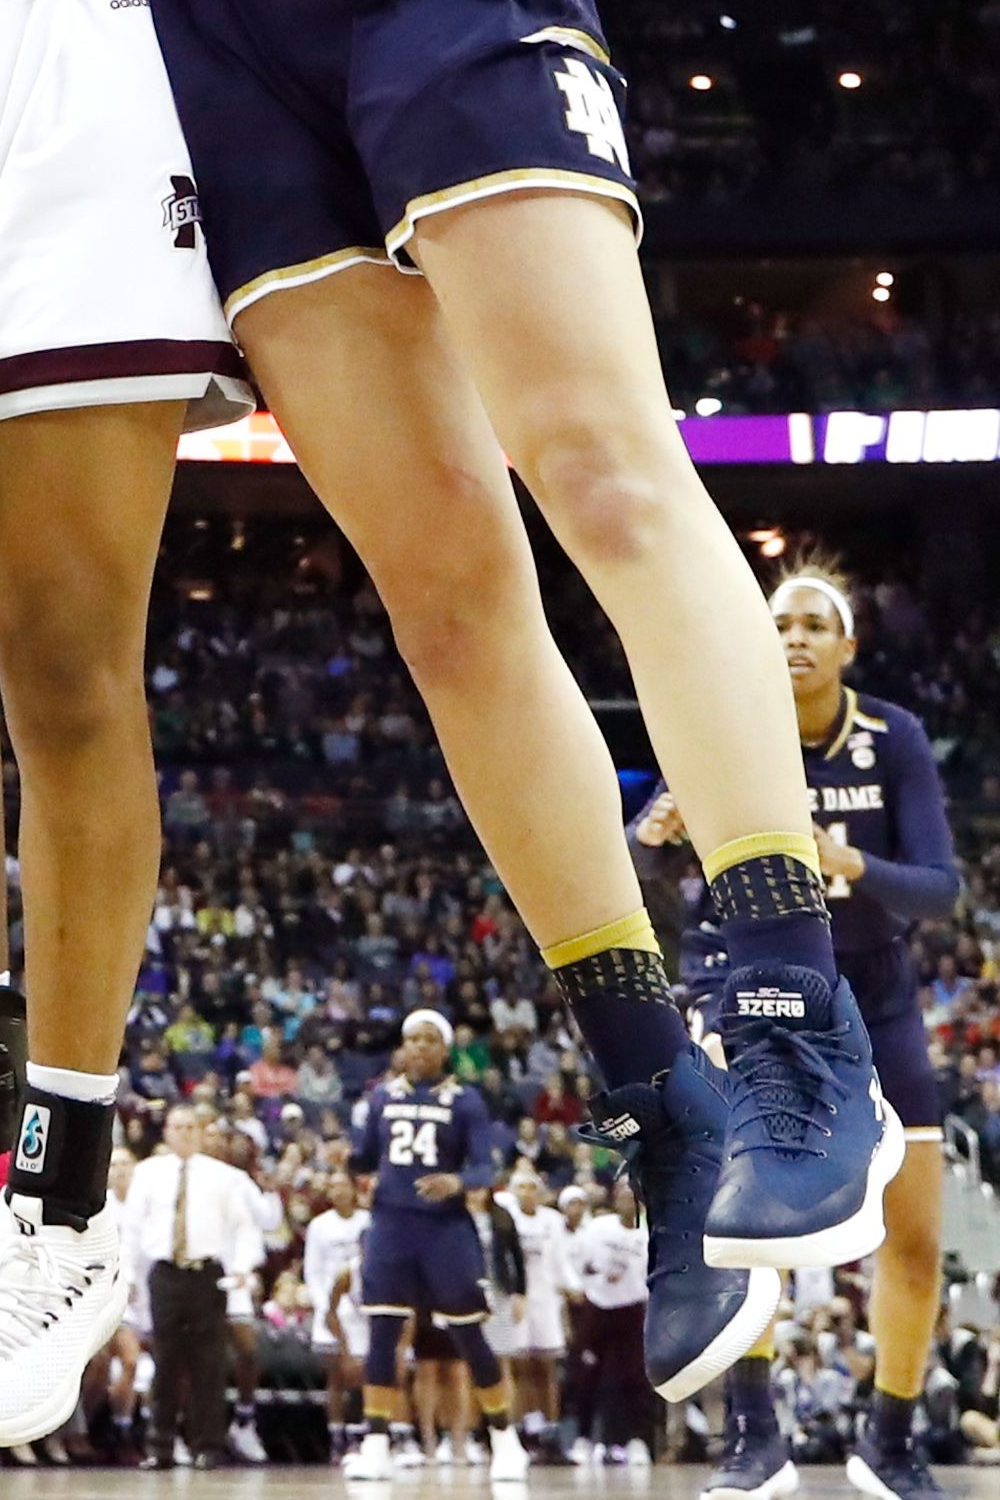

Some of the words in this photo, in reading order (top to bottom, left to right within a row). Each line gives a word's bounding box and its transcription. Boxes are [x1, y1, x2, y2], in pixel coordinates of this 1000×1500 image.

[822, 785, 884, 813] DAME
[611, 1117, 642, 1141] ERO
[389, 1120, 439, 1167] 24
